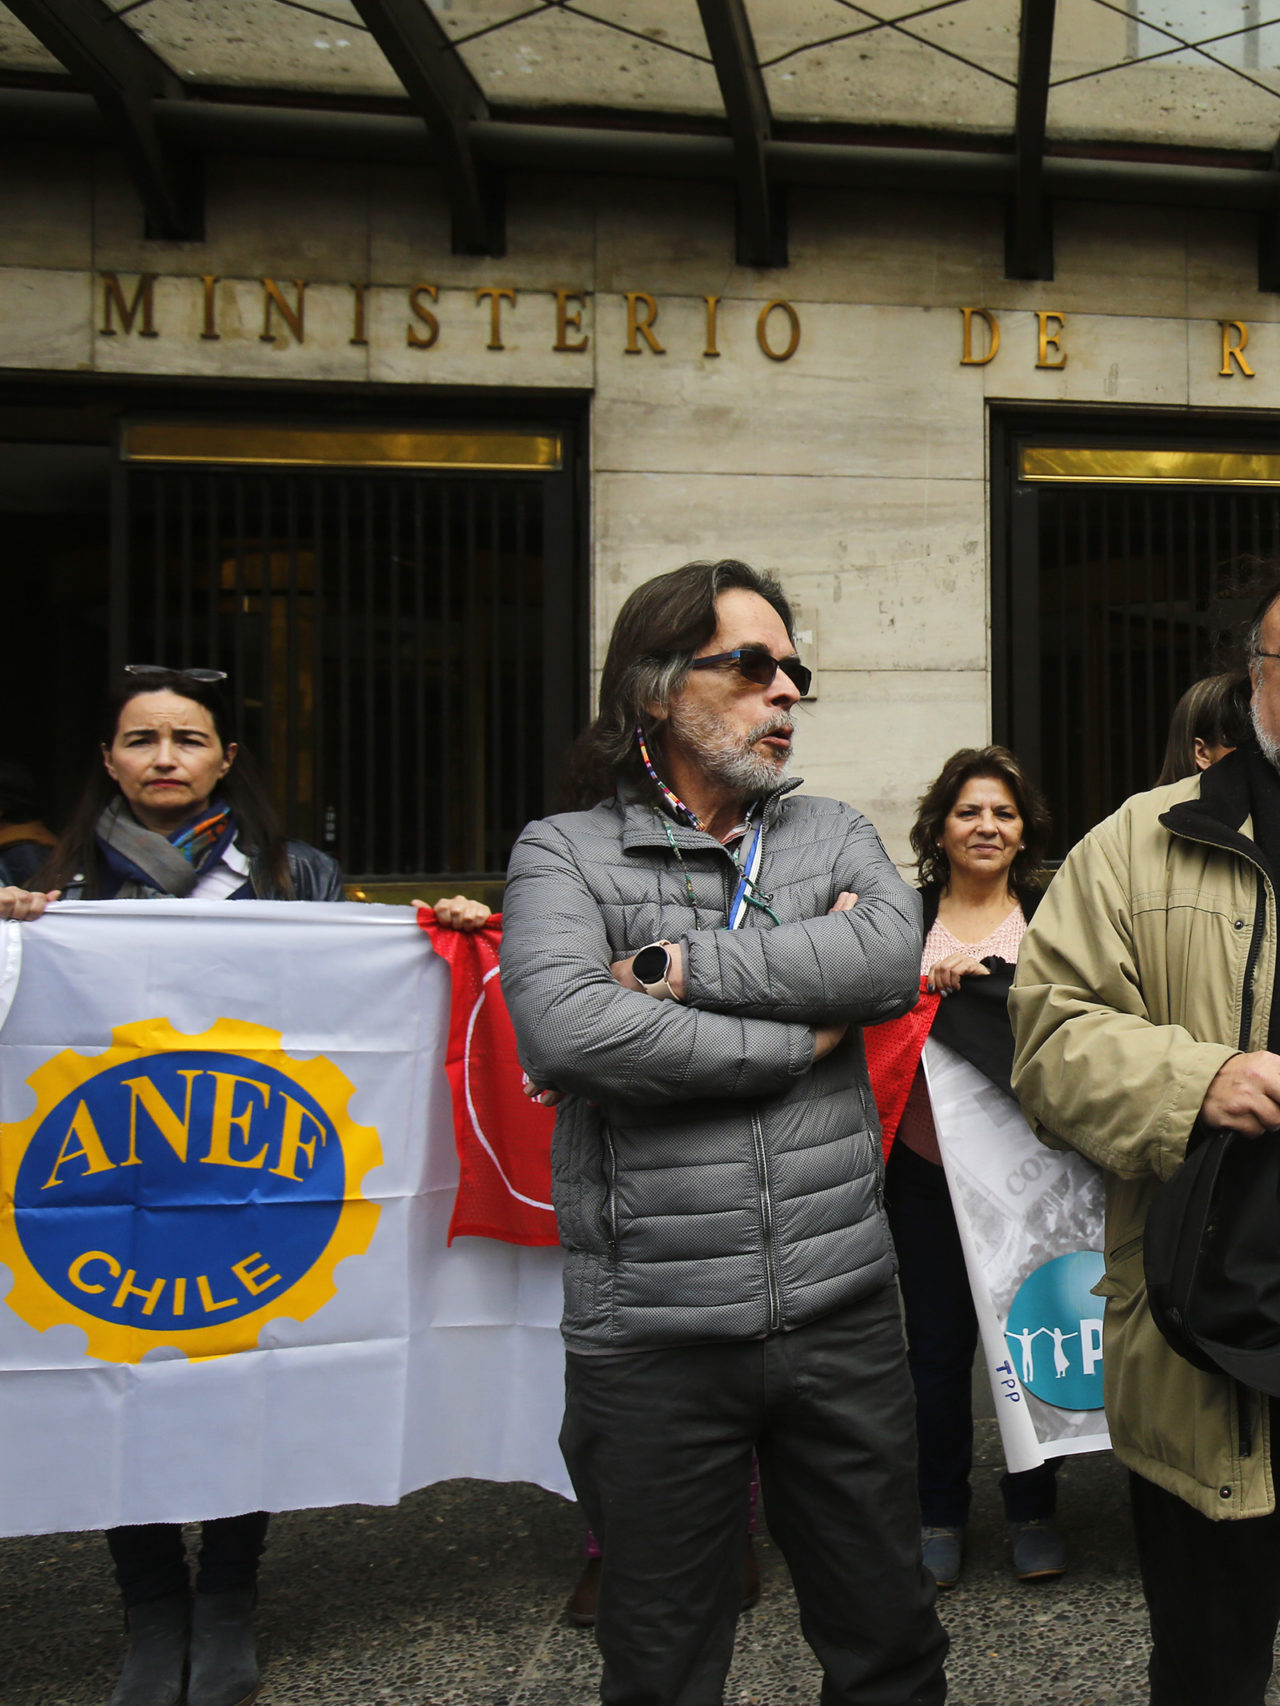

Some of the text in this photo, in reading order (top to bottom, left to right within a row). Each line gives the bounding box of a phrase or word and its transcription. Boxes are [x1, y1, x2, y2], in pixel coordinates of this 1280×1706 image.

[100, 274, 802, 362] MINISTERIO
[959, 306, 1069, 370] DE
[40, 1069, 327, 1190] ANEF
[67, 1250, 283, 1316] CHILE
[995, 1360, 1021, 1403] TPP
